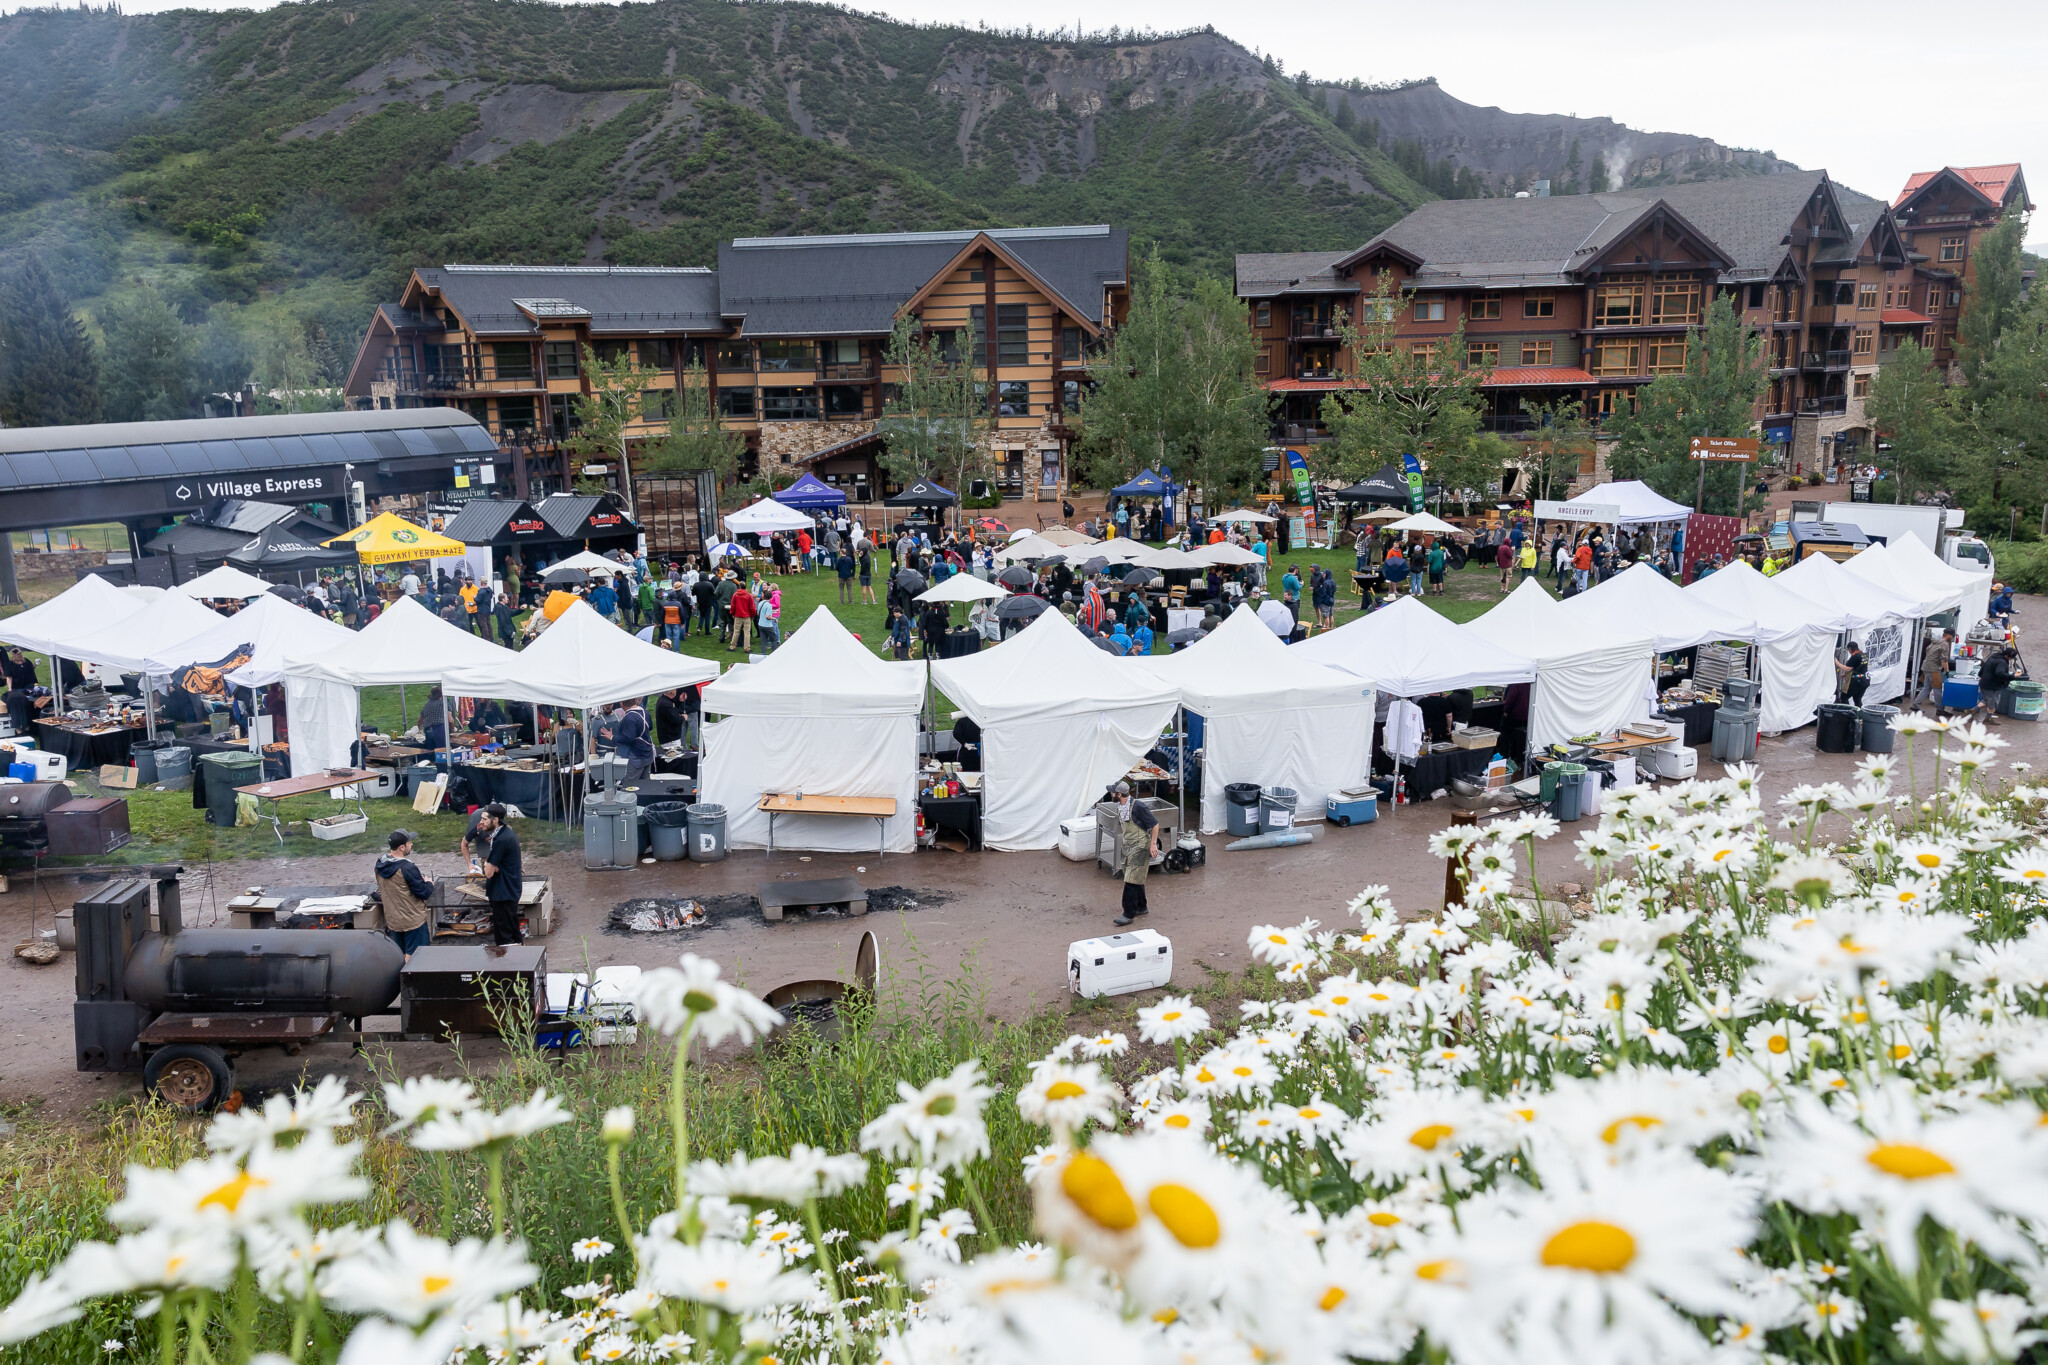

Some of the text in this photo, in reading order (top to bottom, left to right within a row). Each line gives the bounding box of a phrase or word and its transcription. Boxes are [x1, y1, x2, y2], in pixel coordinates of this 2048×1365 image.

[206, 478, 323, 496] Village Express
[414, 548, 441, 558] YERBA
[443, 546, 463, 555] MATE
[699, 833, 716, 853] D
